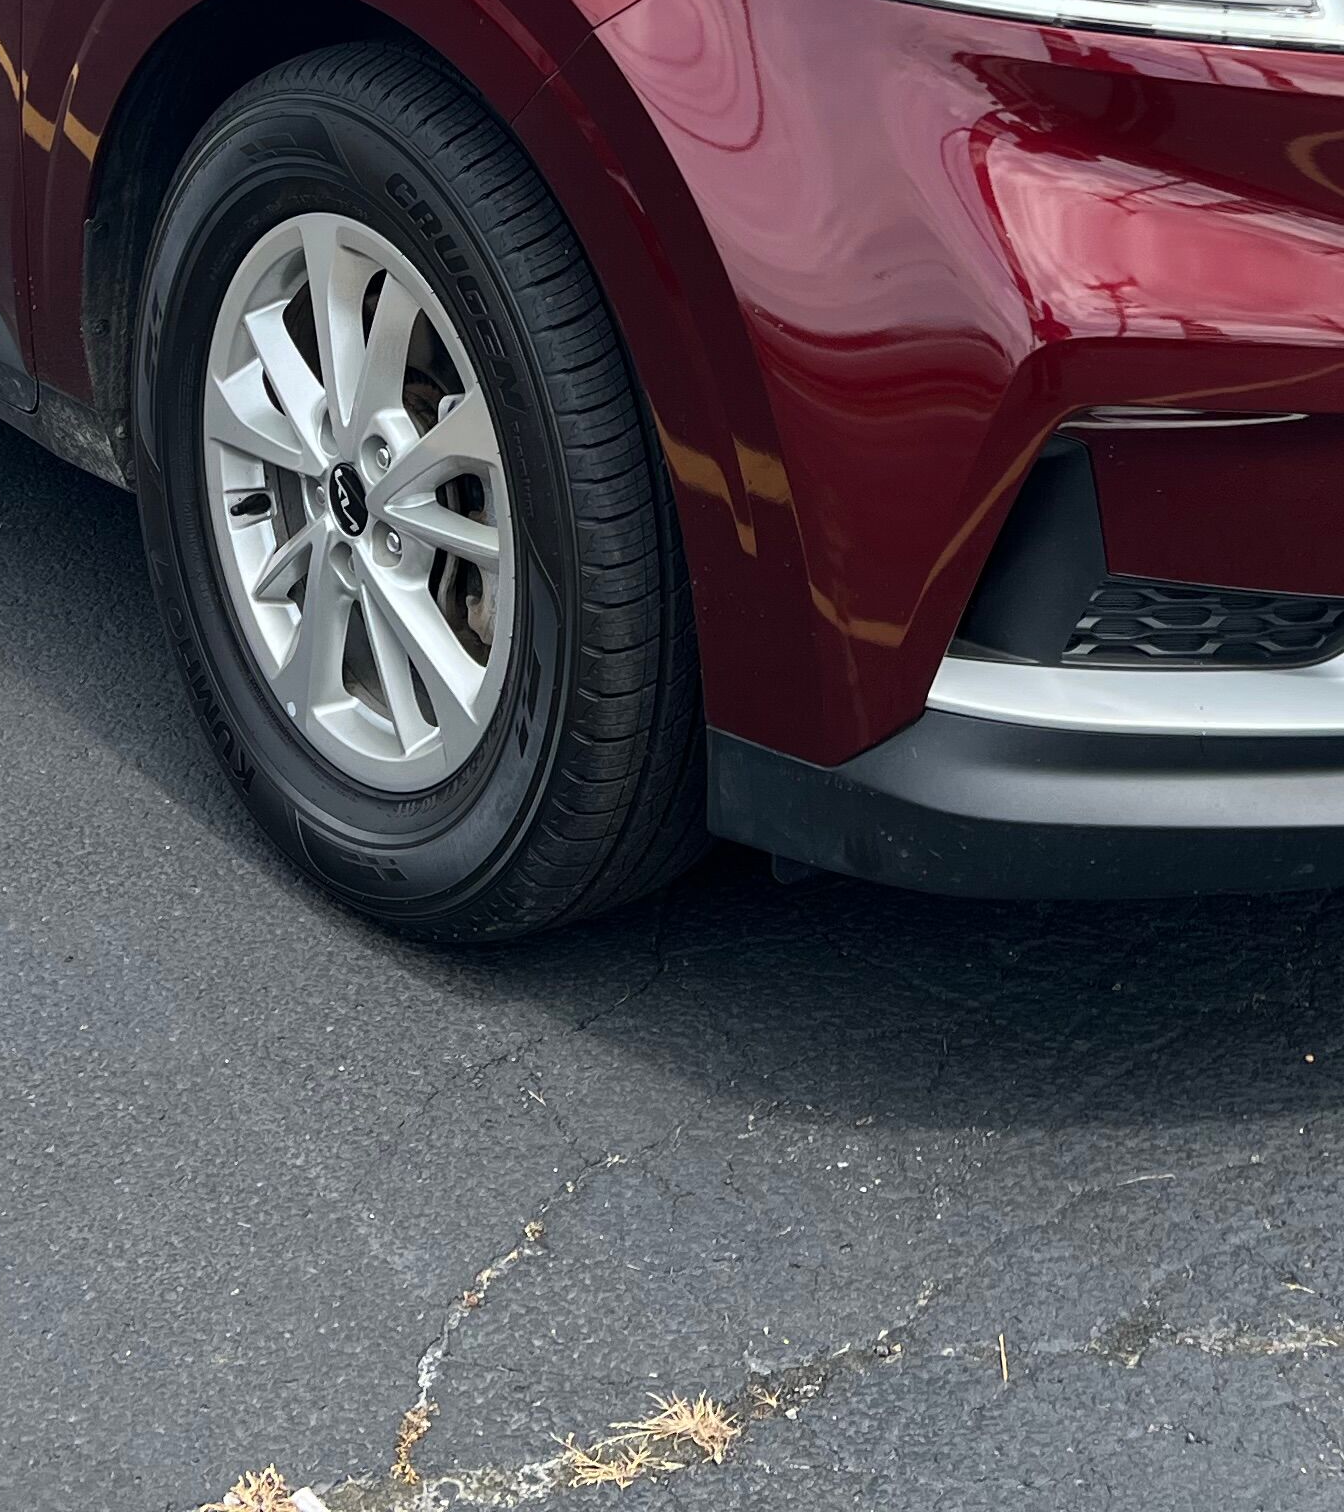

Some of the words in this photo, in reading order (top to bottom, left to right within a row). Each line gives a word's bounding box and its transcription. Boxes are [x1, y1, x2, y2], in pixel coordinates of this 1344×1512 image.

[385, 172, 529, 415] CRUGEN
[334, 468, 360, 532] KIA
[167, 598, 256, 797] KUMHO
